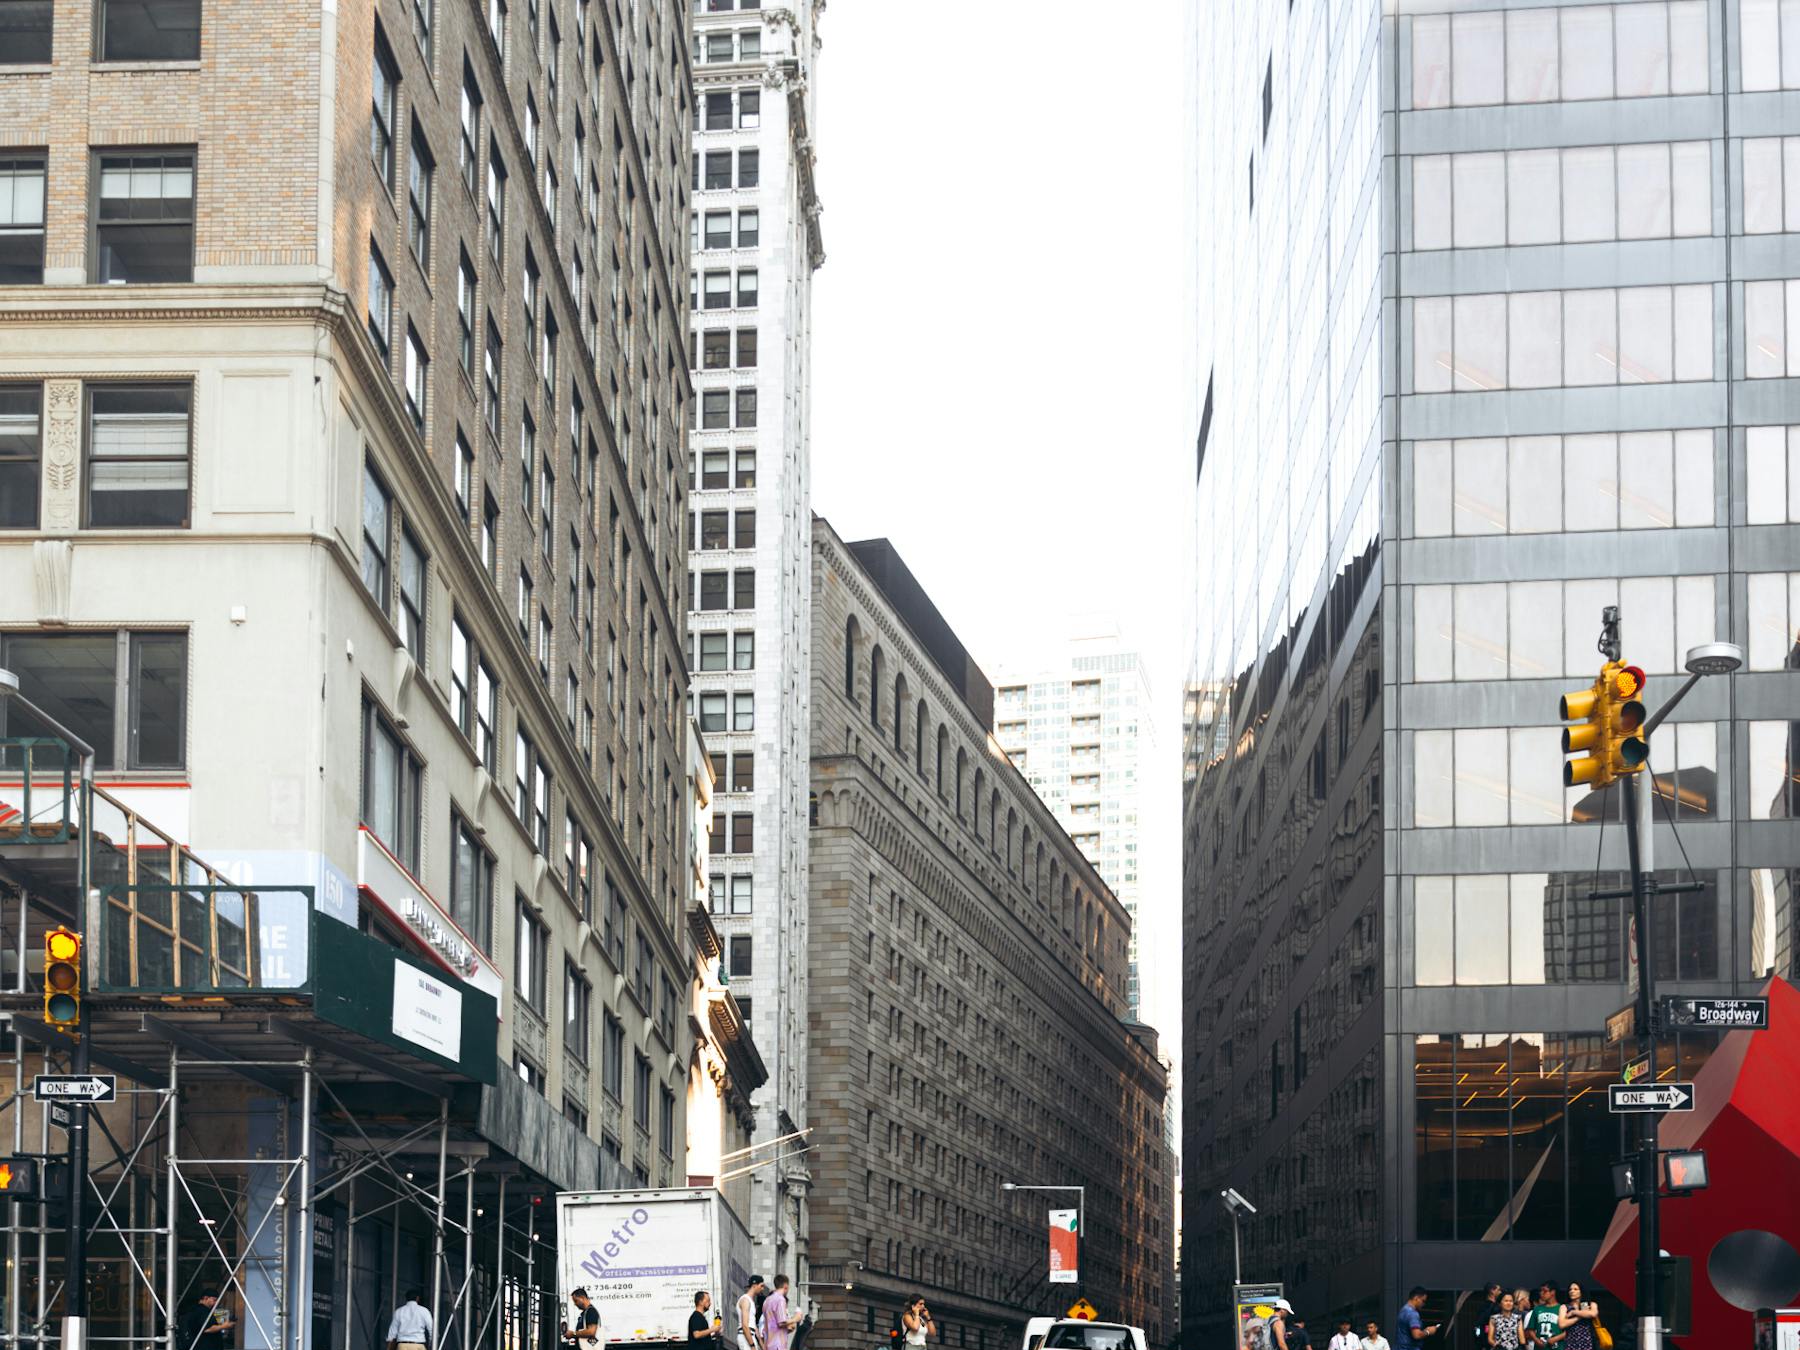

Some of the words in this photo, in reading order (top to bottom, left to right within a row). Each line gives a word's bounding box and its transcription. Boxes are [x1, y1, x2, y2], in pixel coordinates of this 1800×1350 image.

[1699, 1006, 1760, 1024] Broadway
[46, 1083, 69, 1093] ONE
[80, 1083, 102, 1093] WAY
[1622, 1093, 1645, 1103] ONE
[1656, 1093, 1681, 1103] WAY
[314, 1212, 334, 1231] PRIME
[313, 1230, 333, 1249] RETAIL
[580, 1208, 649, 1279] Metro
[594, 1283, 633, 1291] 736-4200
